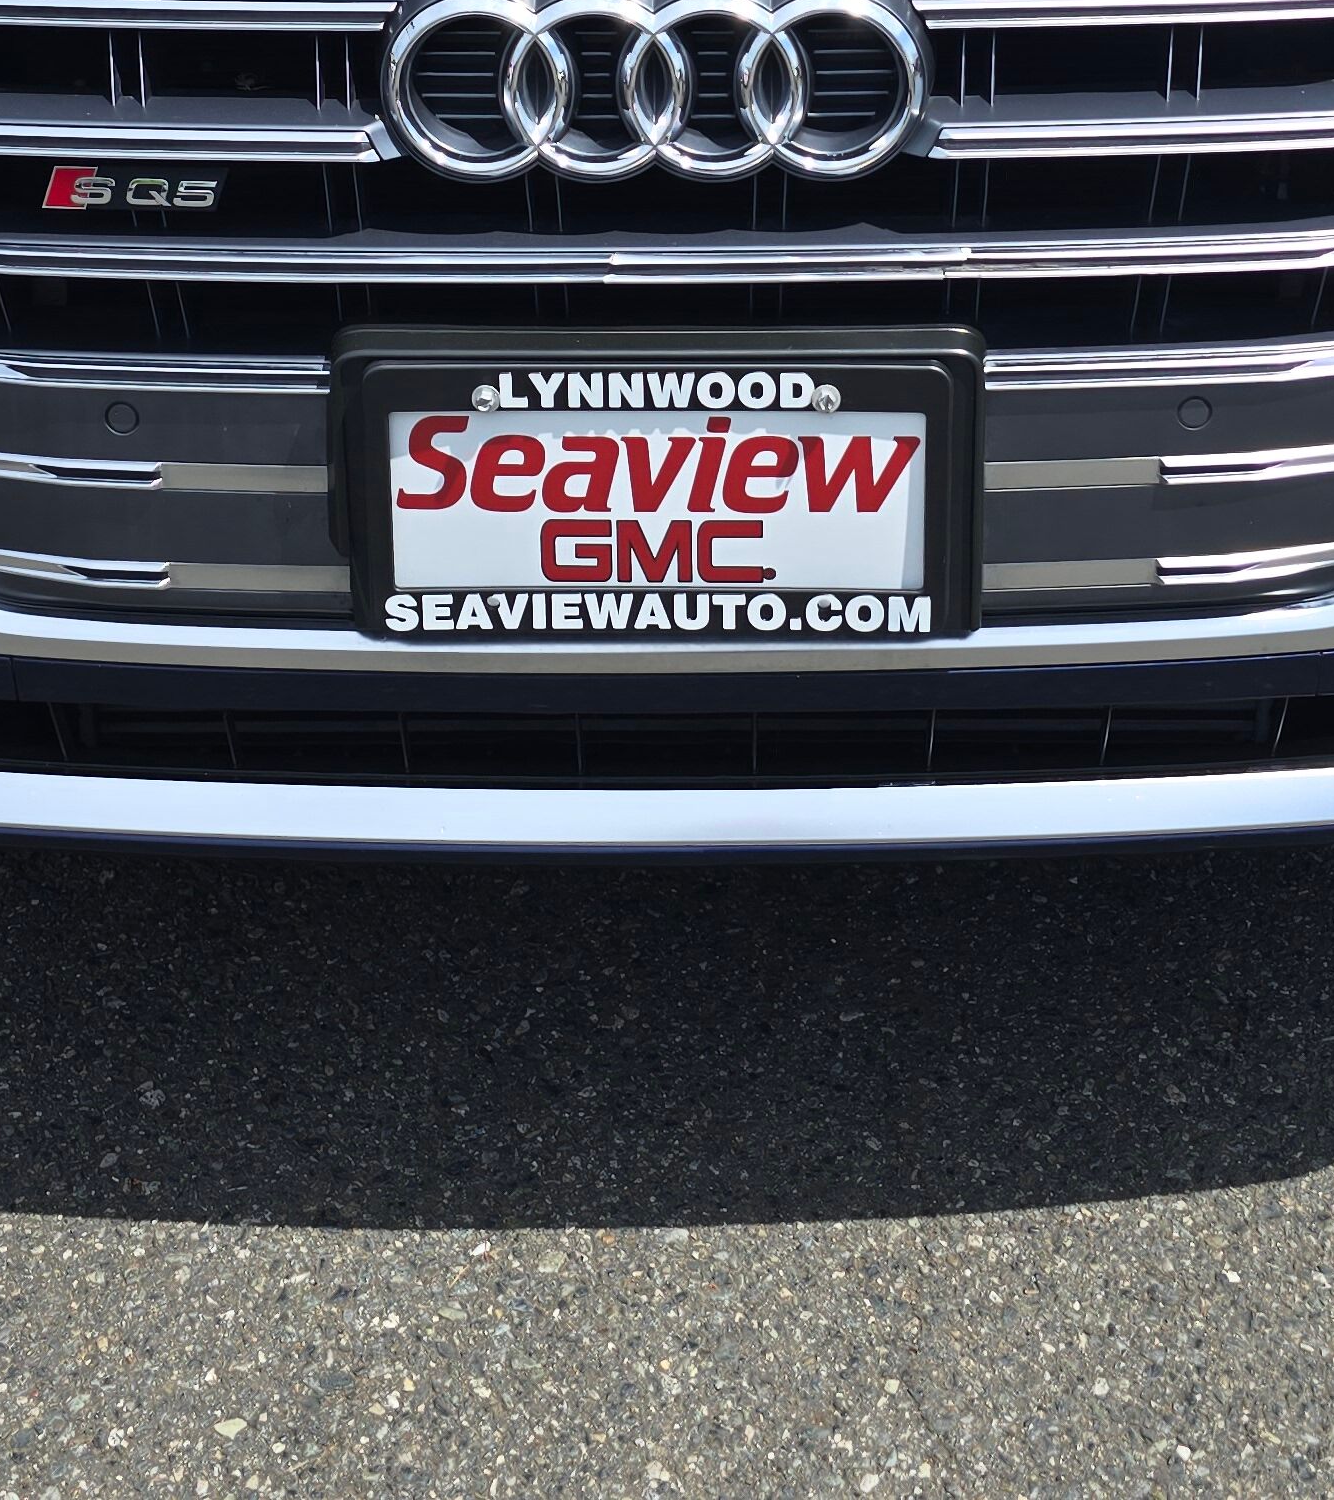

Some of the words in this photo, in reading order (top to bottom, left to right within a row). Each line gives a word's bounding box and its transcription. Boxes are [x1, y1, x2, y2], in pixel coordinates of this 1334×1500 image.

[497, 371, 817, 410] LYNNWOOD
[395, 415, 922, 513] Seaview
[539, 519, 767, 584] GMC
[383, 593, 932, 634] SEAVIEWAUTO.COM
